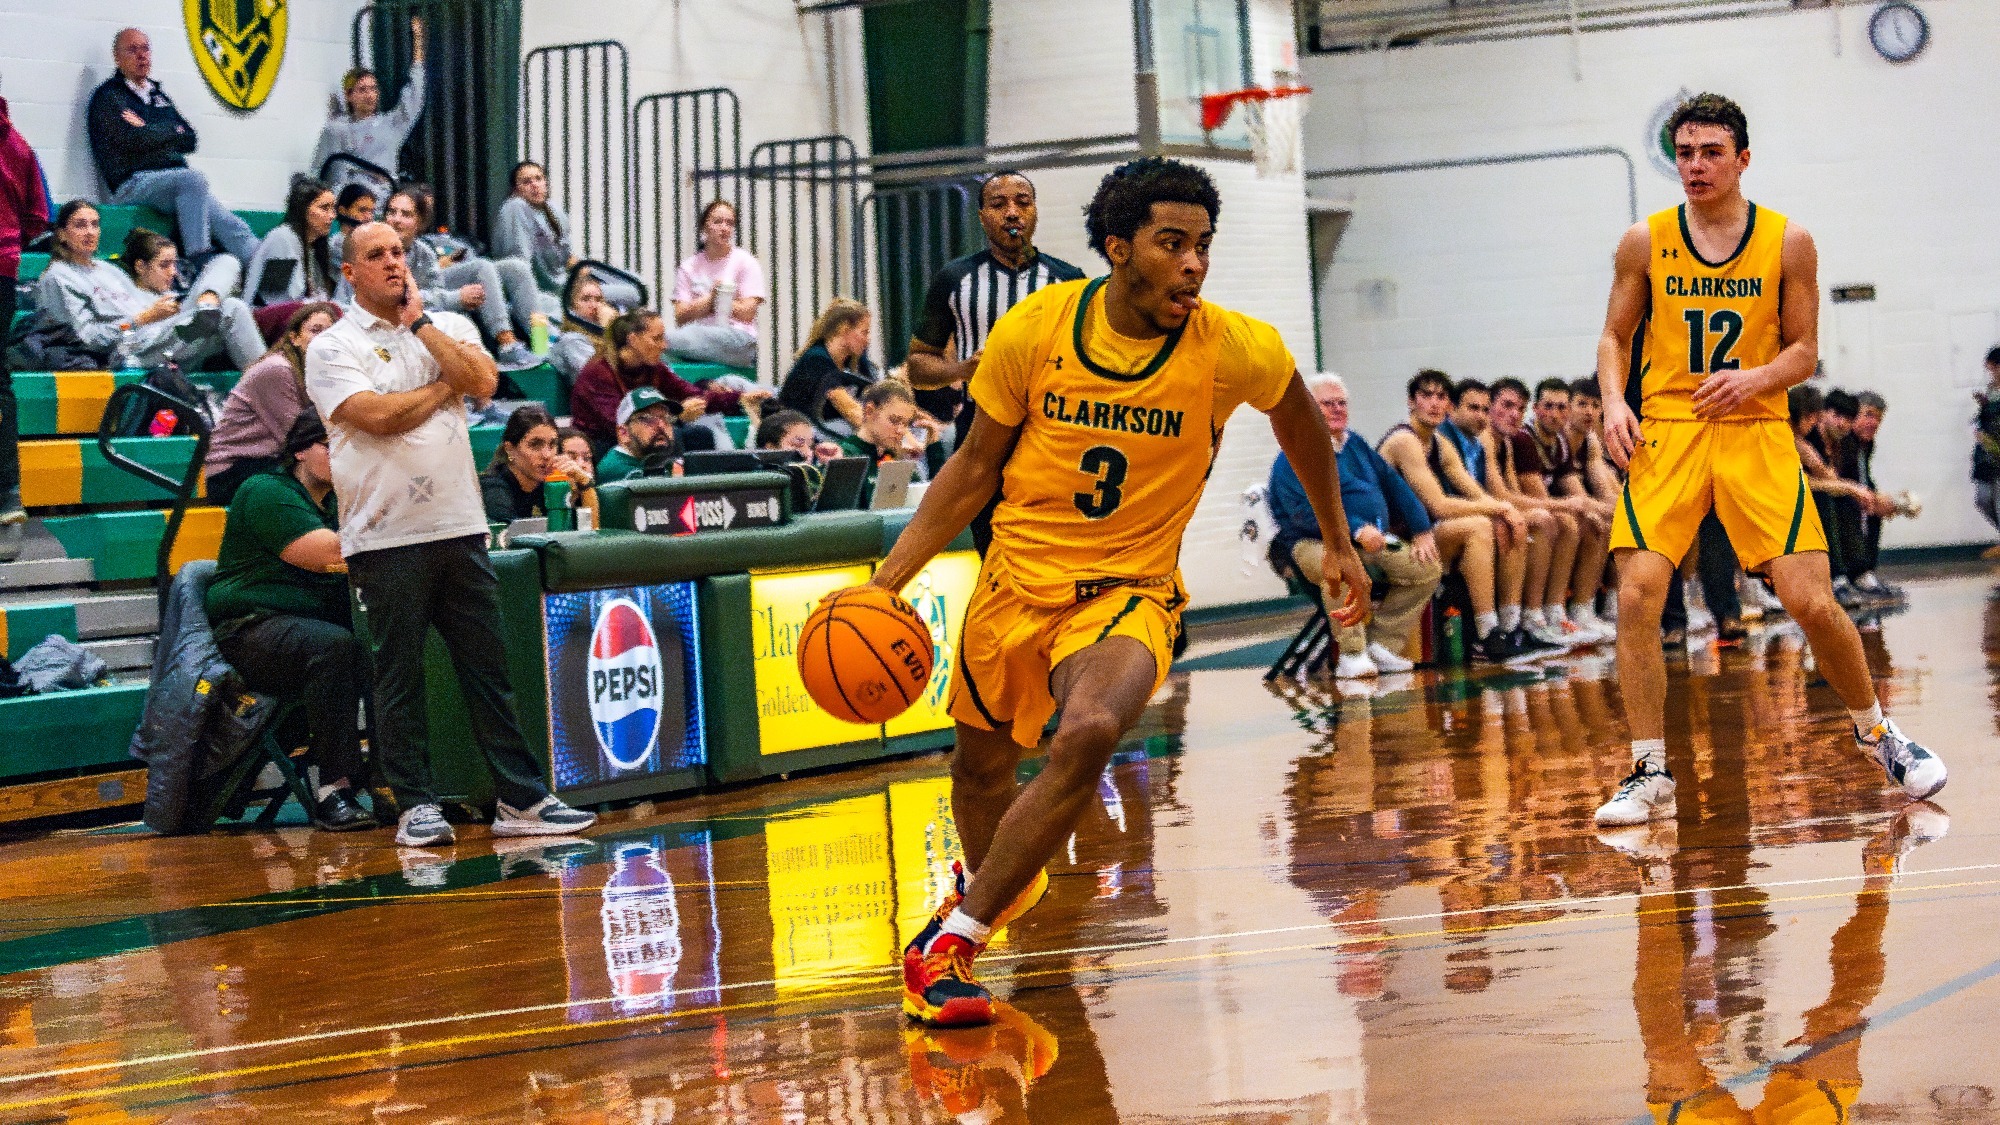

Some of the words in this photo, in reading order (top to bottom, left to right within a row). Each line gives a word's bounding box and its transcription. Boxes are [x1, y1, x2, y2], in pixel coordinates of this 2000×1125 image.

[1665, 275, 1762, 298] CLARKSON
[1683, 308, 1744, 375] 12
[1042, 391, 1184, 438] CLARKSON
[1073, 444, 1129, 520] 3
[592, 664, 657, 704] PEPSI
